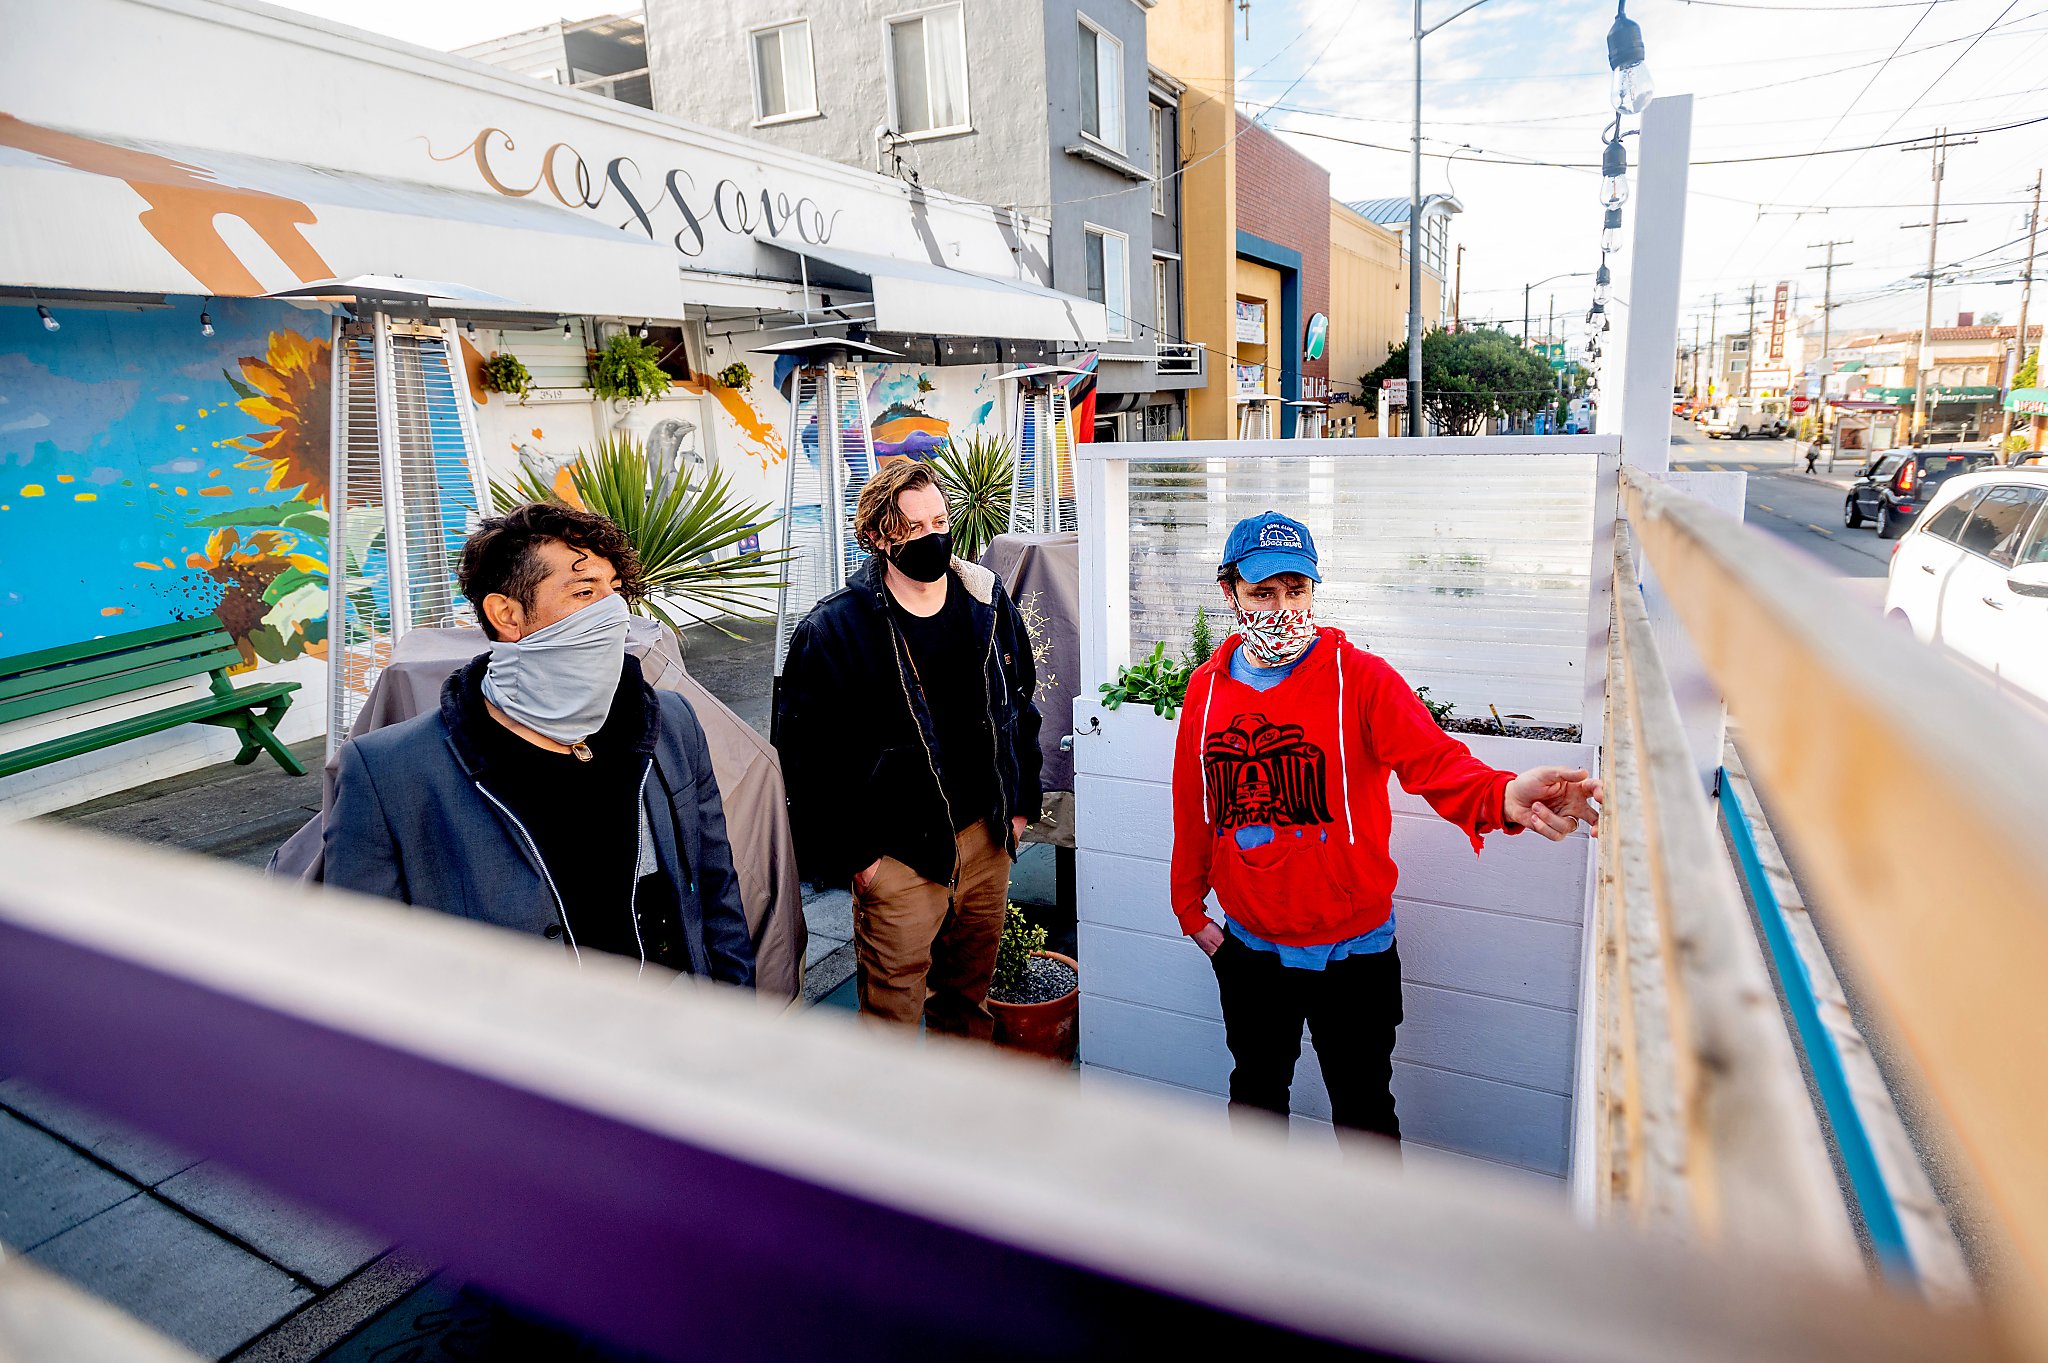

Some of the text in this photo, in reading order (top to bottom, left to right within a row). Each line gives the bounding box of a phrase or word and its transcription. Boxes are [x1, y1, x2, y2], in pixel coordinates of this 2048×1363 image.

[415, 127, 844, 257] cassava
[1301, 376, 1314, 399] Full
[1315, 376, 1328, 398] Life
[1791, 400, 1810, 409] STOP
